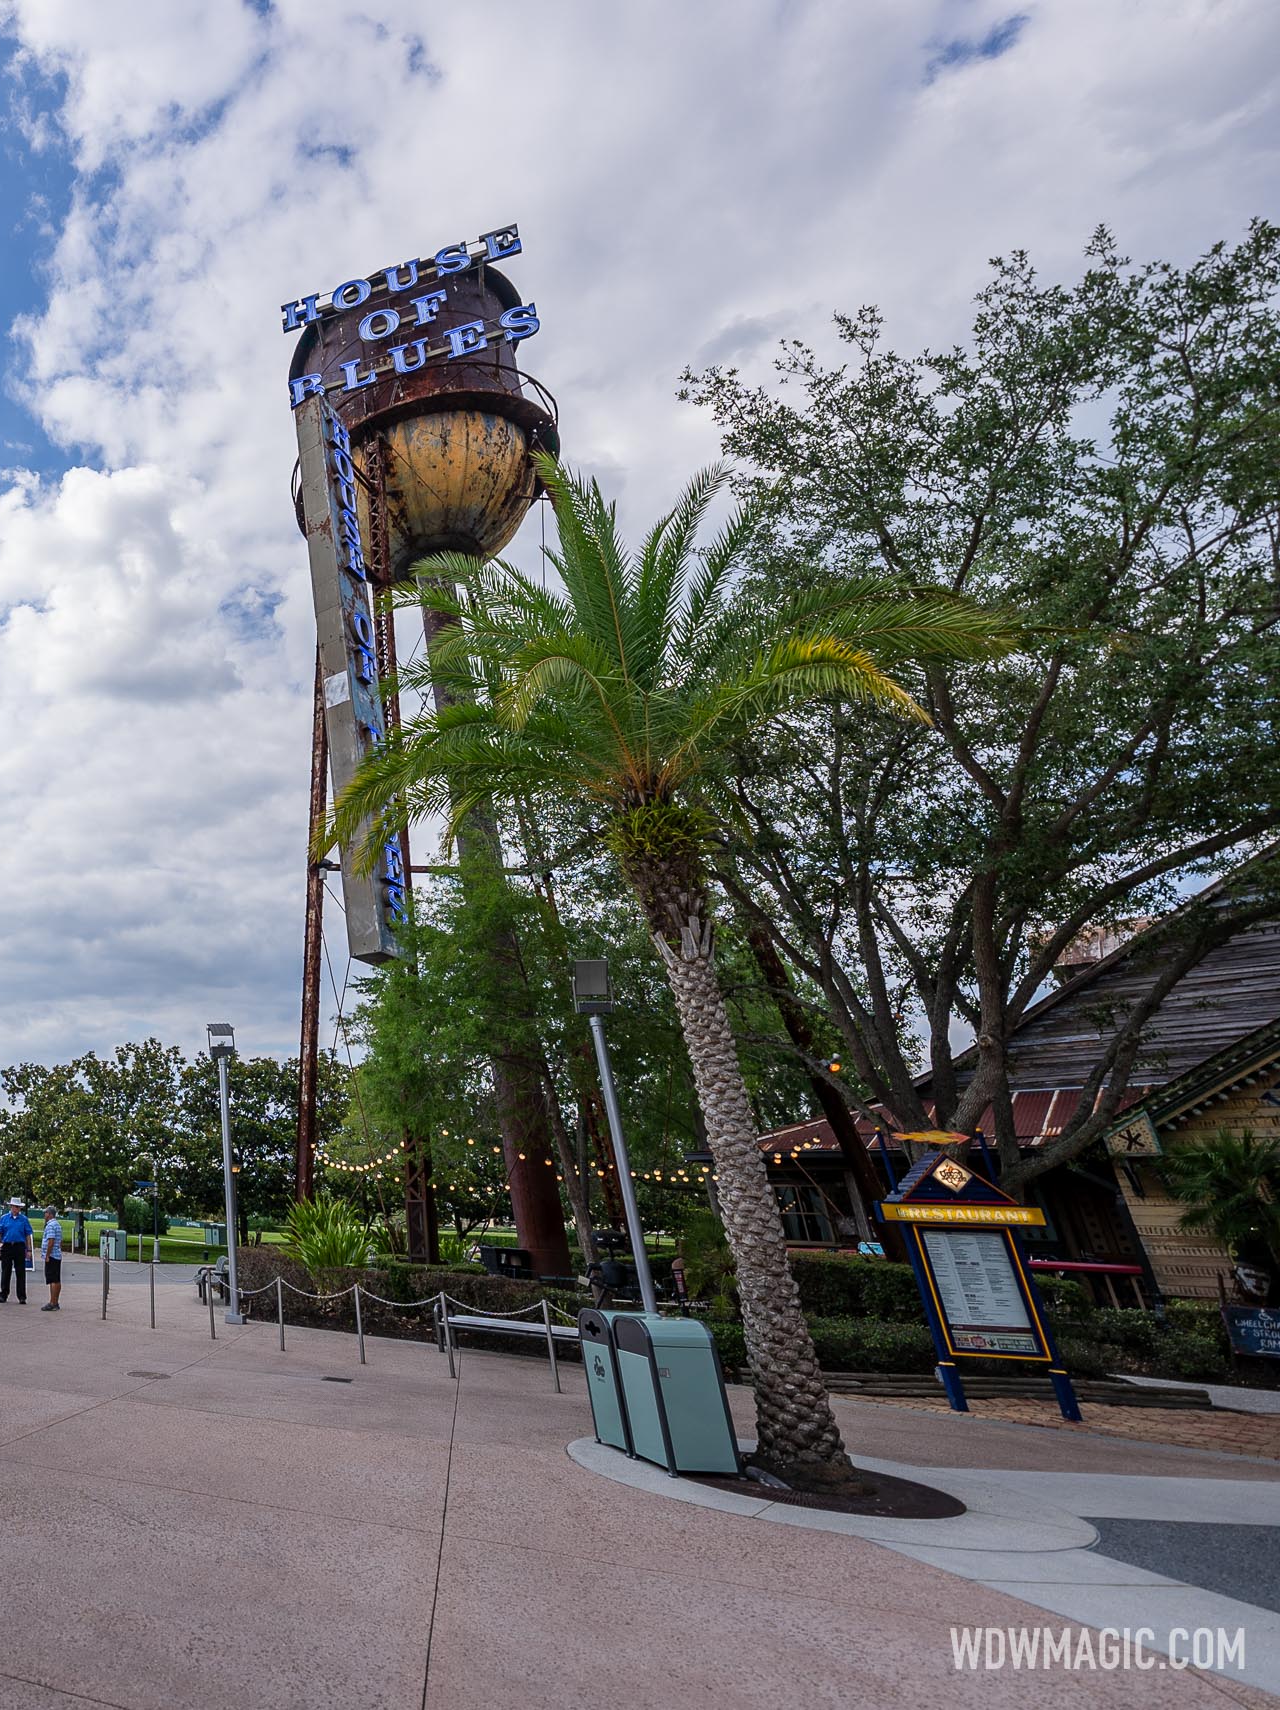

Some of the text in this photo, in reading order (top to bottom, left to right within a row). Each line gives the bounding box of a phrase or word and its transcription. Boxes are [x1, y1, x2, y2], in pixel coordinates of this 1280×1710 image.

[281, 224, 522, 333] HOUSE
[358, 289, 448, 342] OF
[289, 302, 540, 410] BLUES
[327, 415, 367, 582] HOUSE
[352, 612, 378, 685] OF
[908, 1207, 1030, 1222] RESTAURANT
